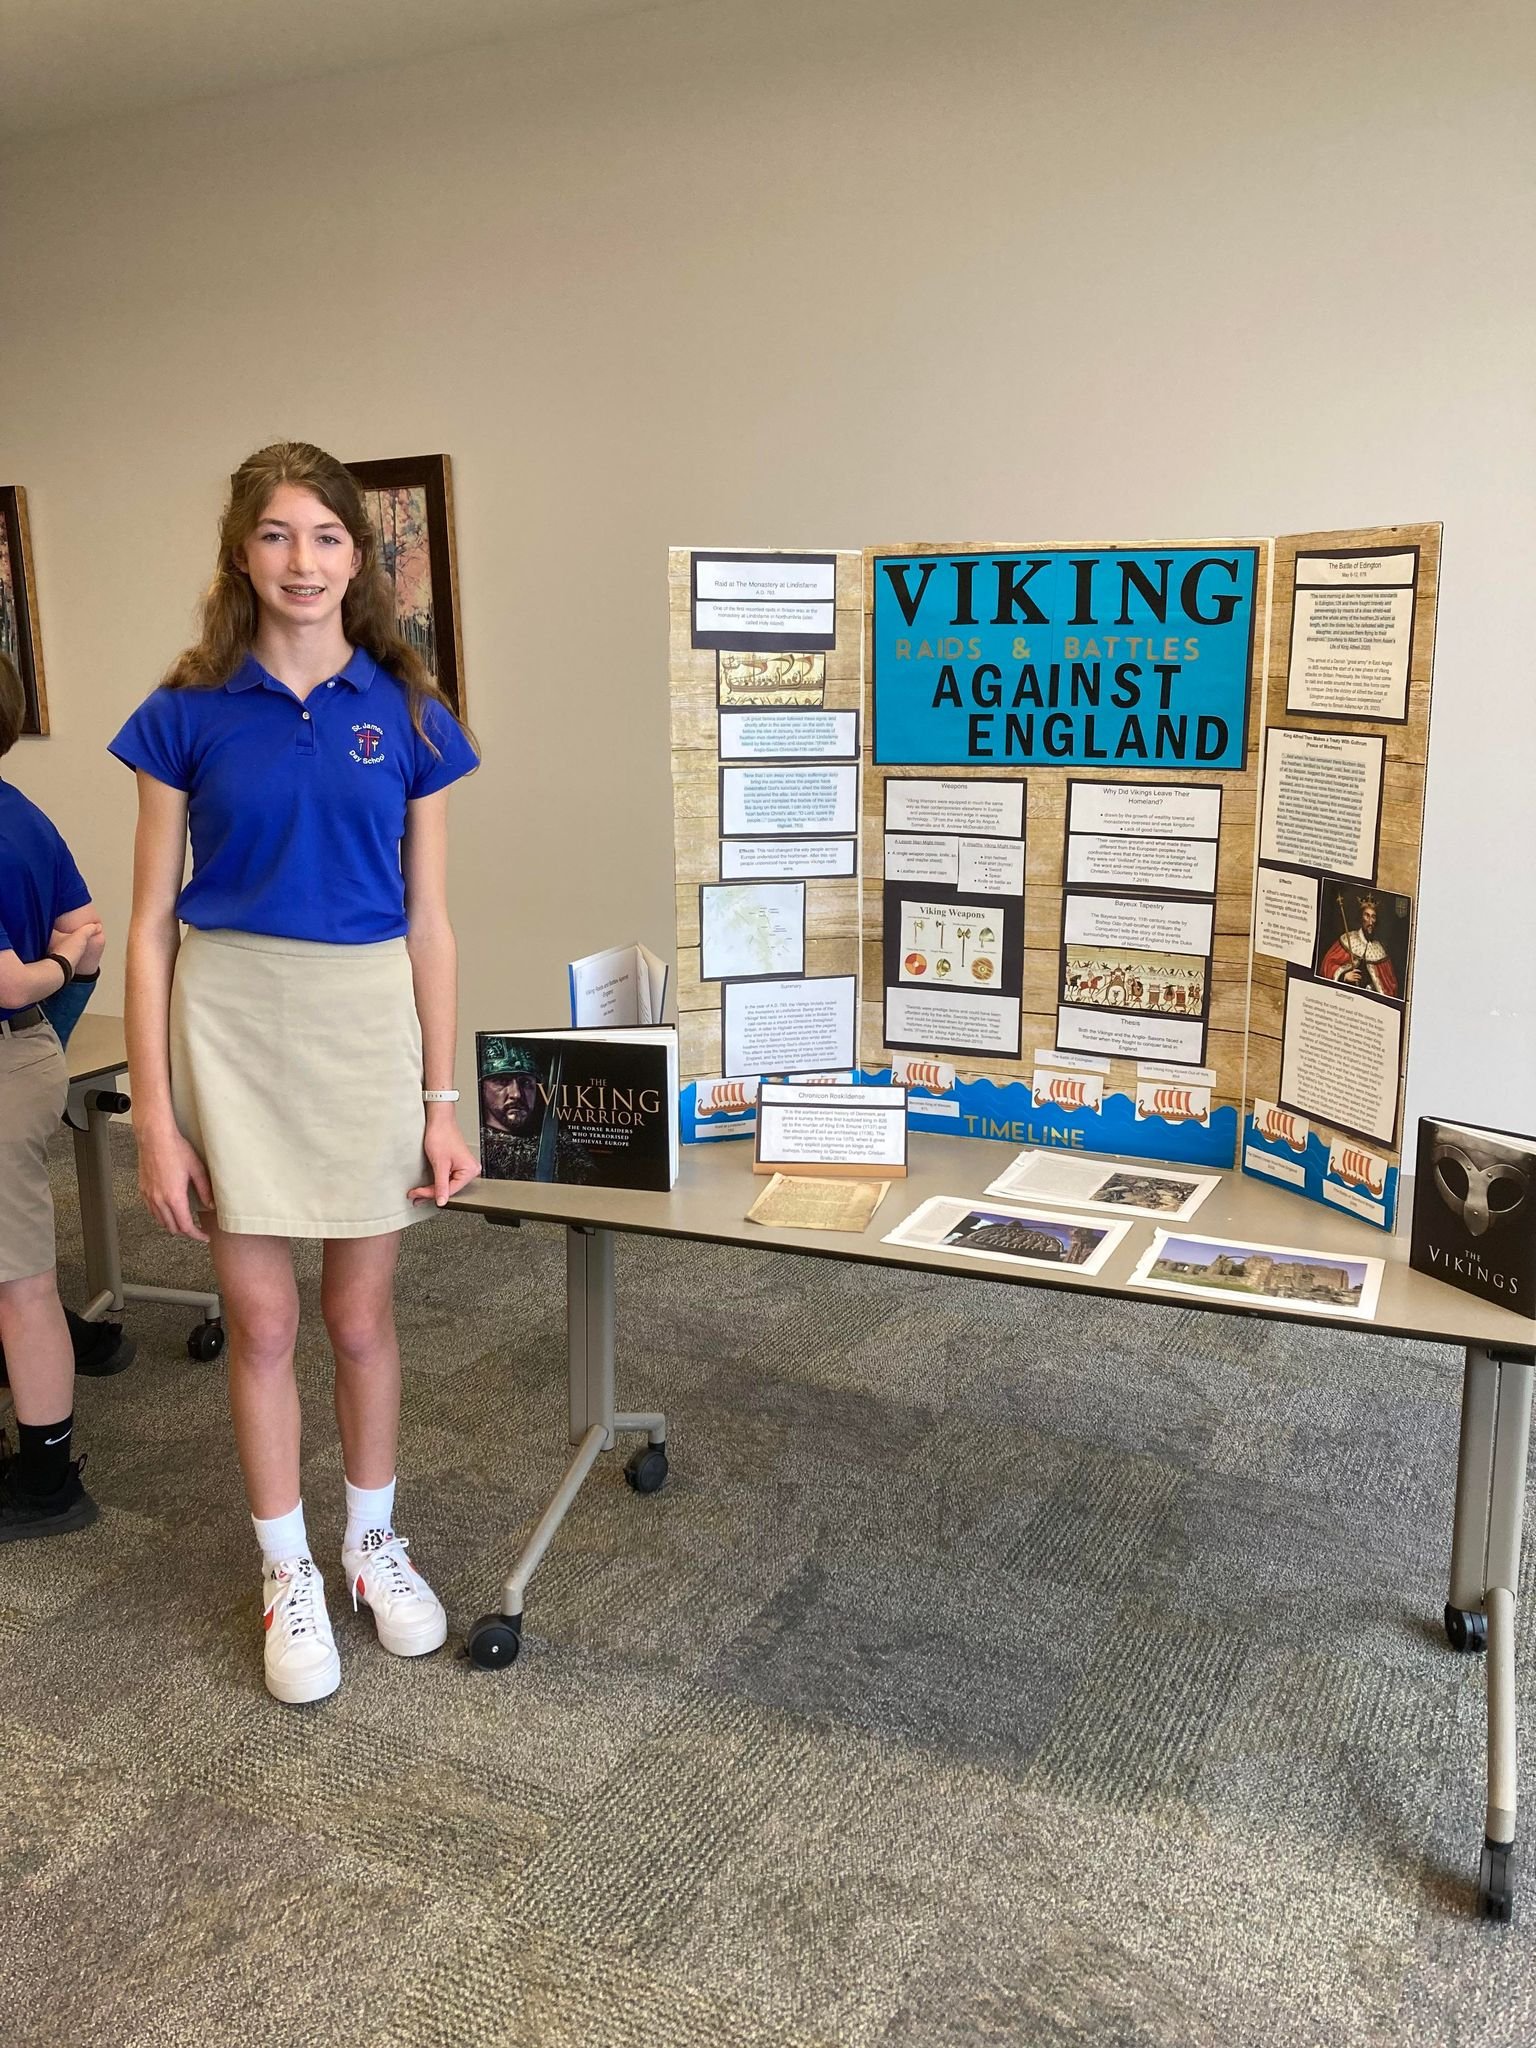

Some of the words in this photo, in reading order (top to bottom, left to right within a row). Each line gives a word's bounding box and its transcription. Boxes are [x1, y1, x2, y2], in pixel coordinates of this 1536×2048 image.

[1360, 562, 1381, 570] Edington
[883, 558, 1243, 626] VIKING
[896, 638, 981, 661] RAIDS
[1012, 637, 1030, 659] &
[1064, 637, 1200, 661] BATTLES
[932, 662, 1182, 709] AGAINST
[362, 723, 384, 735] James
[968, 713, 1229, 761] ENGLAND
[349, 750, 362, 762] Day
[362, 753, 385, 764] School
[1130, 789, 1152, 797] Vikings
[920, 907, 946, 917] Viking
[949, 908, 985, 919] Weapons
[1139, 902, 1164, 910] Tapestry
[1336, 991, 1354, 1001] Summary
[591, 1078, 607, 1086] THE
[536, 1083, 660, 1113] VIKING
[556, 1107, 645, 1126] WARRIOR
[963, 1114, 1084, 1149] TIMELINE
[1465, 1250, 1480, 1262] THE
[1429, 1244, 1518, 1294] VIKINGS
